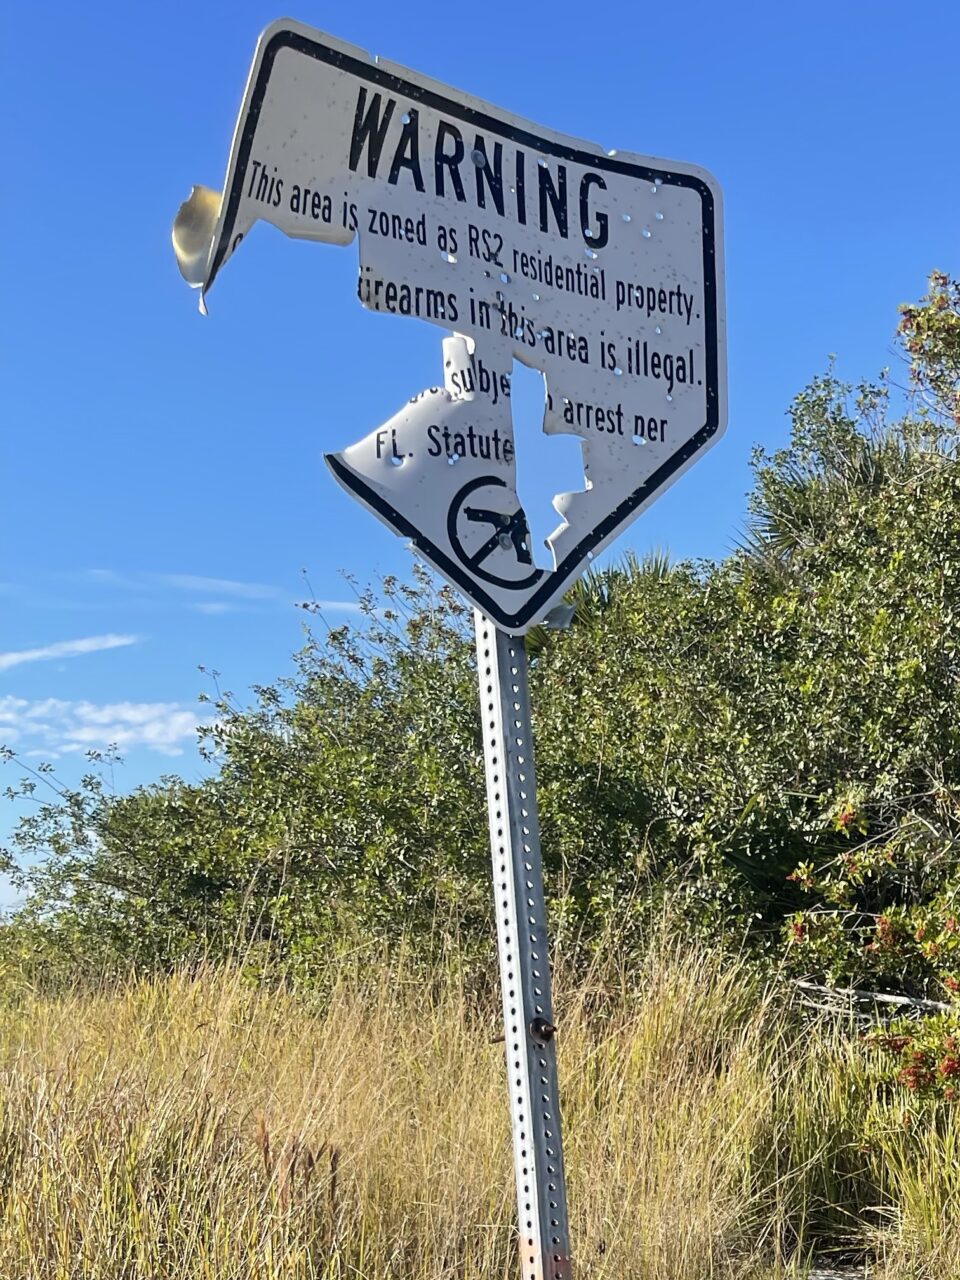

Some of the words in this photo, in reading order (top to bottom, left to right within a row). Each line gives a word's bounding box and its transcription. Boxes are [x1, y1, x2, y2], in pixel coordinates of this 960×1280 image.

[349, 86, 609, 249] WARNING
[247, 160, 283, 208] This
[290, 184, 332, 223] area
[342, 192, 358, 231] is
[367, 208, 427, 246] zoned
[437, 224, 458, 254] as
[468, 223, 504, 268] RS2
[512, 248, 606, 300] residential
[615, 279, 700, 326] property.
[469, 287, 491, 329] in
[499, 300, 537, 348] this
[544, 325, 589, 364] area
[600, 329, 617, 372] is
[627, 337, 703, 396] illegal.
[563, 400, 625, 436] arrest
